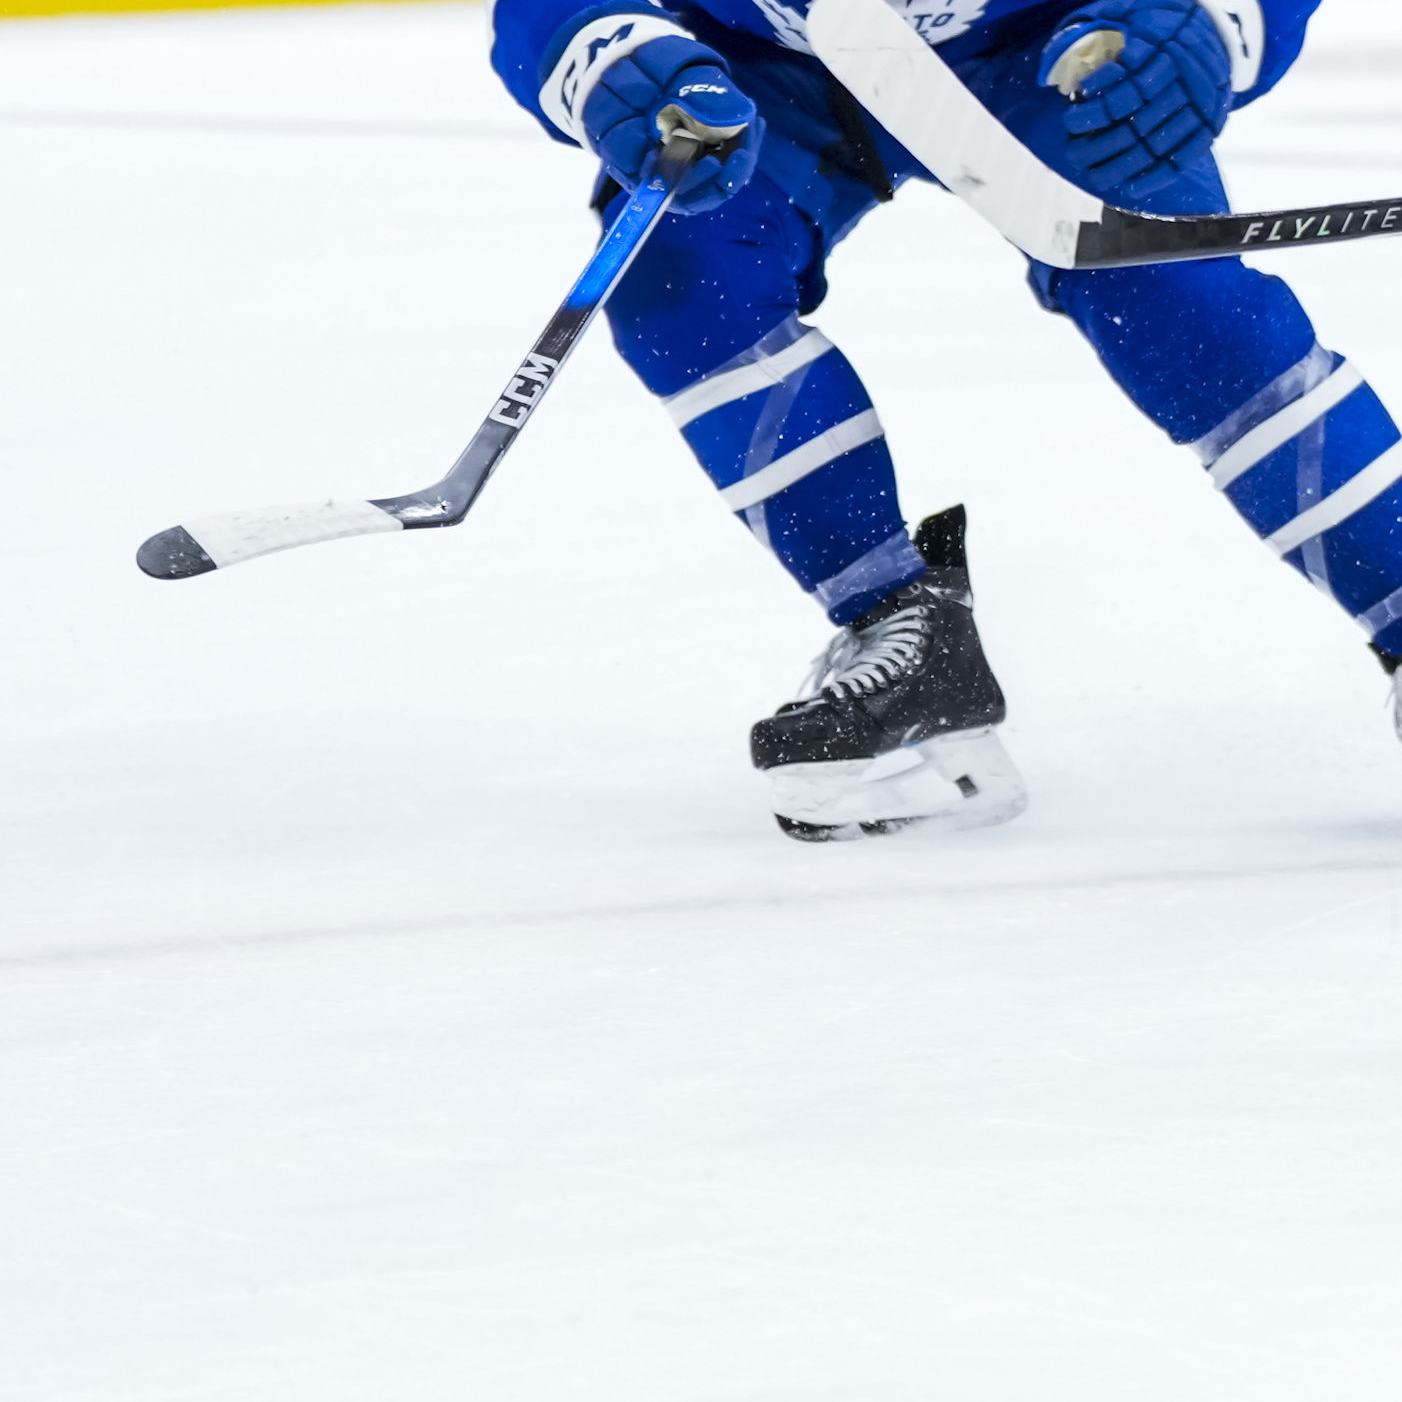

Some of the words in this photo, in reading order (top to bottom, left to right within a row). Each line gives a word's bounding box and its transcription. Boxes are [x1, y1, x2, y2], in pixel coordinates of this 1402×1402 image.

[678, 83, 729, 98] CCM
[1240, 206, 1402, 244] FLYLITE
[488, 351, 559, 429] CCM
